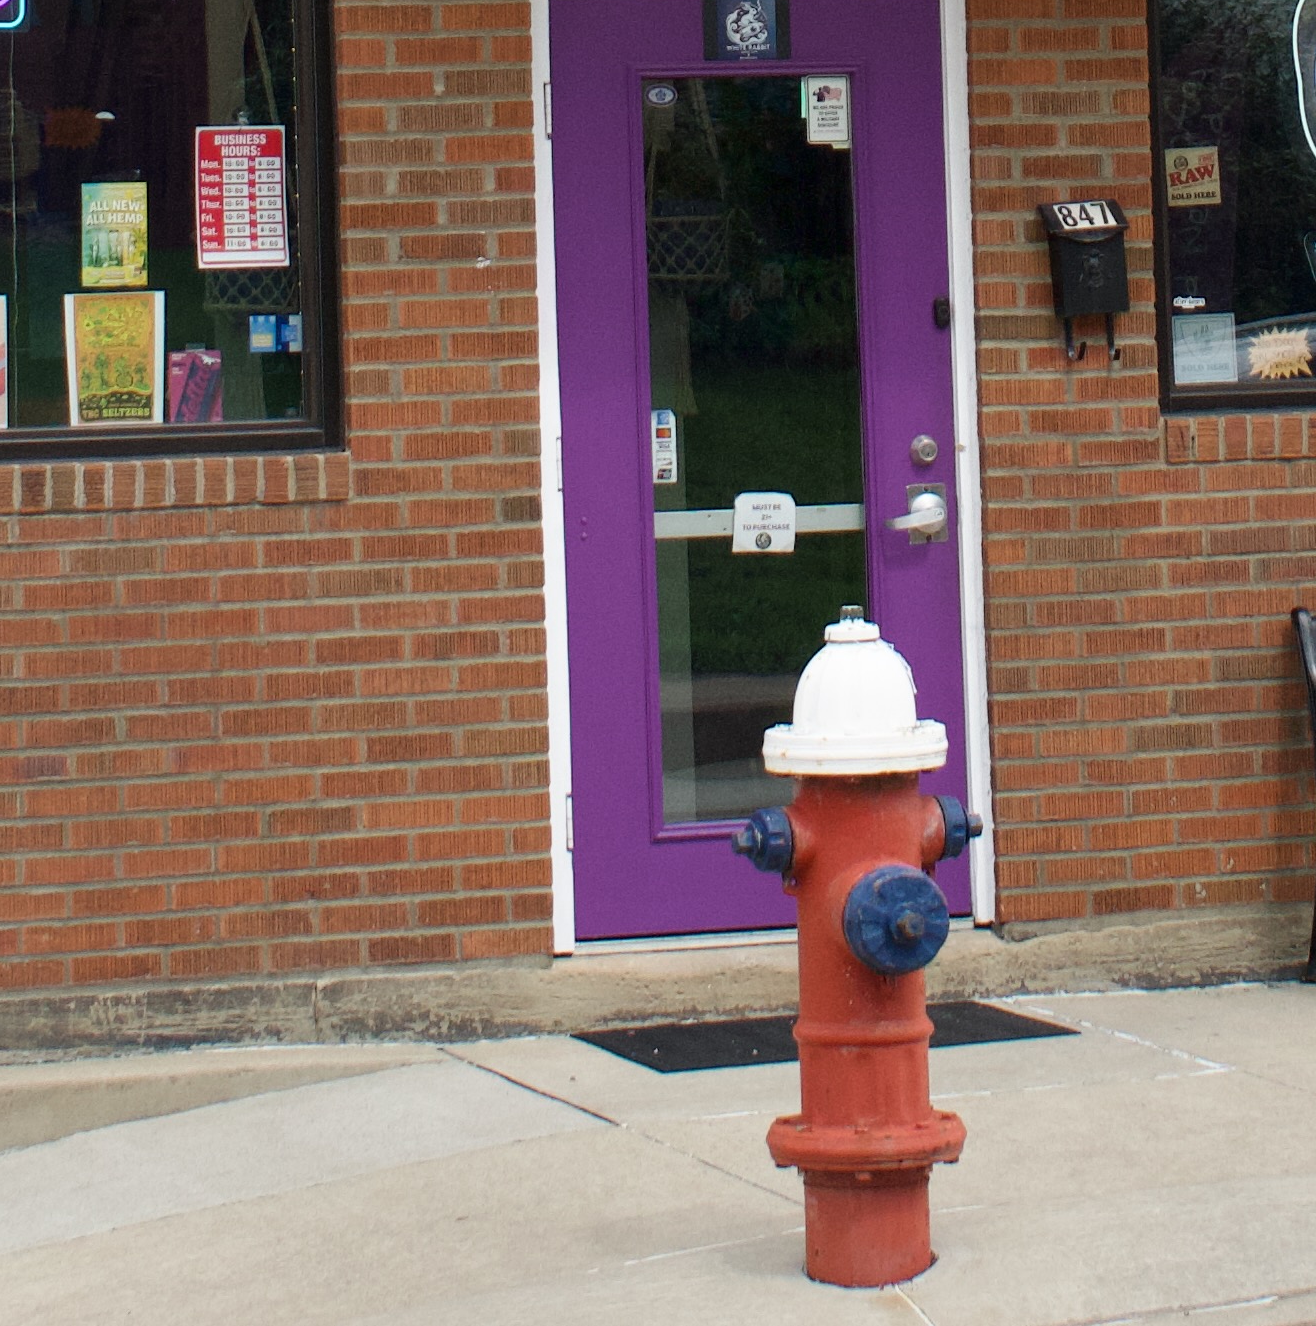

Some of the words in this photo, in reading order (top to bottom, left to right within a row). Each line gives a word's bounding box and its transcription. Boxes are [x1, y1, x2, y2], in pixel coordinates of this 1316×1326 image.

[214, 133, 266, 145] BUSINESS
[221, 145, 261, 157] HOURS:
[1169, 164, 1215, 186] RAW
[1171, 192, 1192, 200] SOLD
[1193, 191, 1217, 199] HERE
[89, 200, 109, 213] ALL
[112, 199, 141, 212] NEW
[86, 213, 106, 226] ALL
[107, 212, 144, 225] HEMP
[1057, 202, 1109, 227] 847
